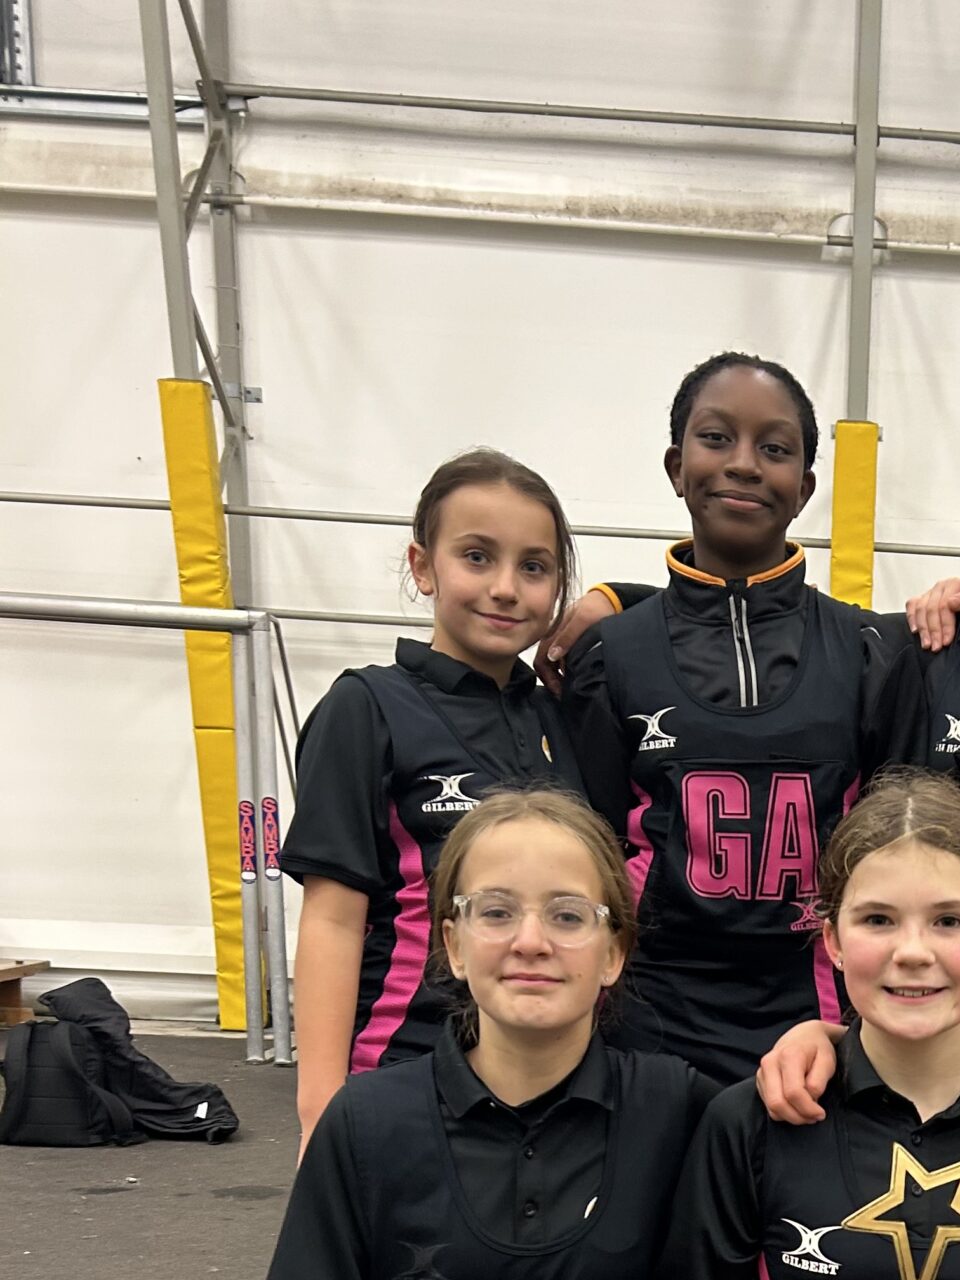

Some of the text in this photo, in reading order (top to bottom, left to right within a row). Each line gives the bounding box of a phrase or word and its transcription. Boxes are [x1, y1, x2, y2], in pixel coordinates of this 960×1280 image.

[239, 801, 256, 872] SAMBA
[262, 797, 280, 868] SAMBA
[682, 770, 820, 900] GA
[781, 1252, 840, 1276] GILBERT
